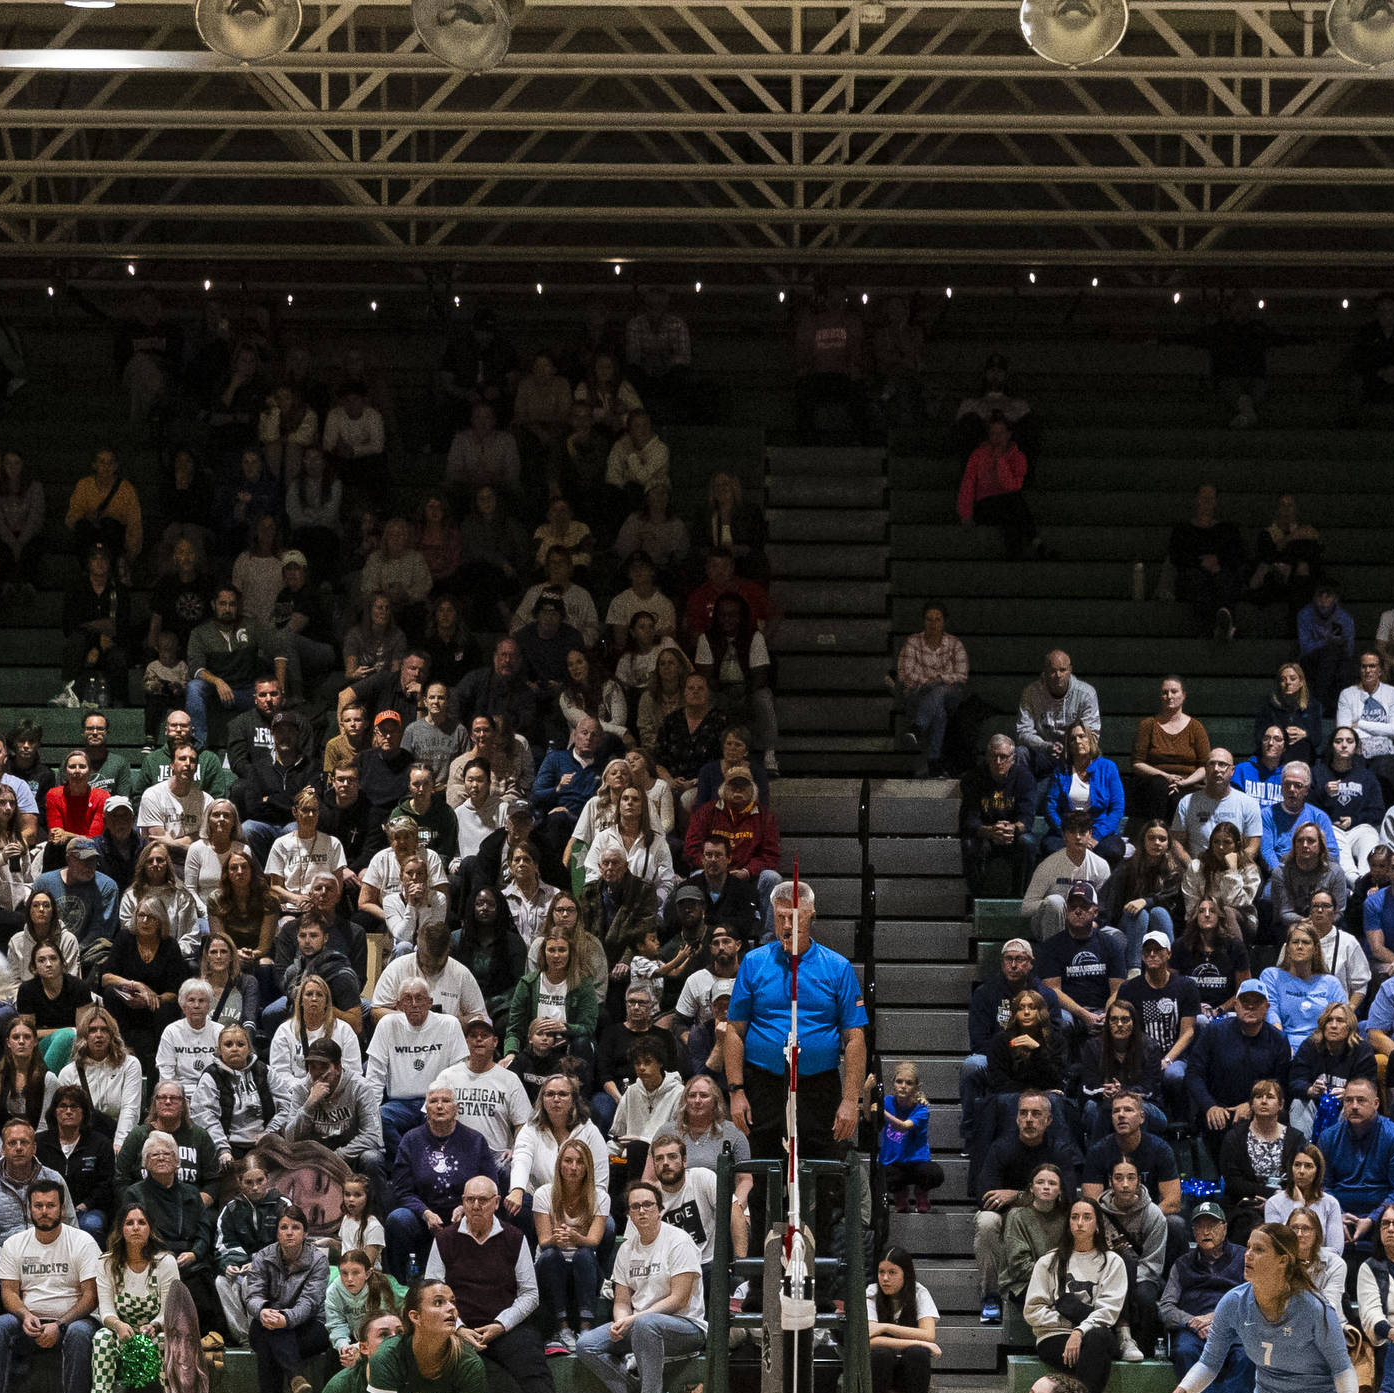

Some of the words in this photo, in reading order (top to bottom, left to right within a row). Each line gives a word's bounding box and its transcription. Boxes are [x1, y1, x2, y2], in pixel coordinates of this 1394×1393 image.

[174, 1046, 215, 1055] WILDCA
[394, 1043, 443, 1055] WILDCAT
[457, 1101, 496, 1118] STATE
[22, 1263, 69, 1275] WILDCATS
[1262, 1341, 1274, 1367] 7
